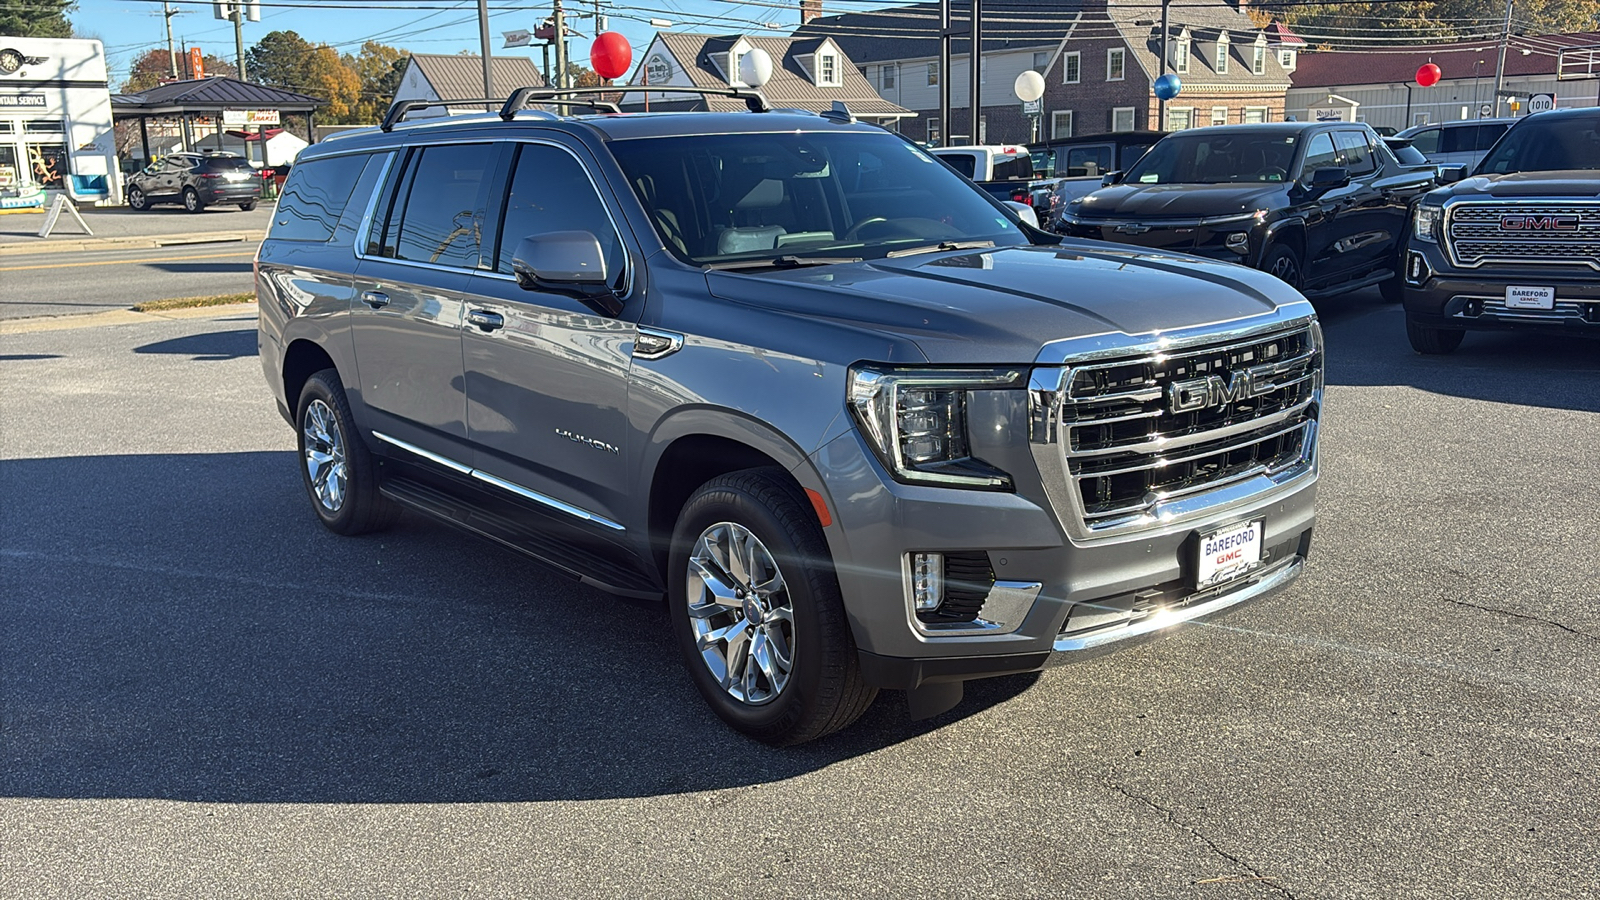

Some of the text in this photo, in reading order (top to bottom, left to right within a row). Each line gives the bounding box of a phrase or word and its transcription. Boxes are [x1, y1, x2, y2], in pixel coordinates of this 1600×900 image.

[18, 96, 45, 105] SERVICE
[1531, 100, 1550, 109] 1010
[1502, 216, 1577, 230] GMC
[640, 336, 657, 345] GMC
[1169, 366, 1275, 415] GMC
[555, 428, 619, 456] YUKON
[1205, 529, 1255, 556] BAREFORD
[1217, 549, 1242, 564] GMC
